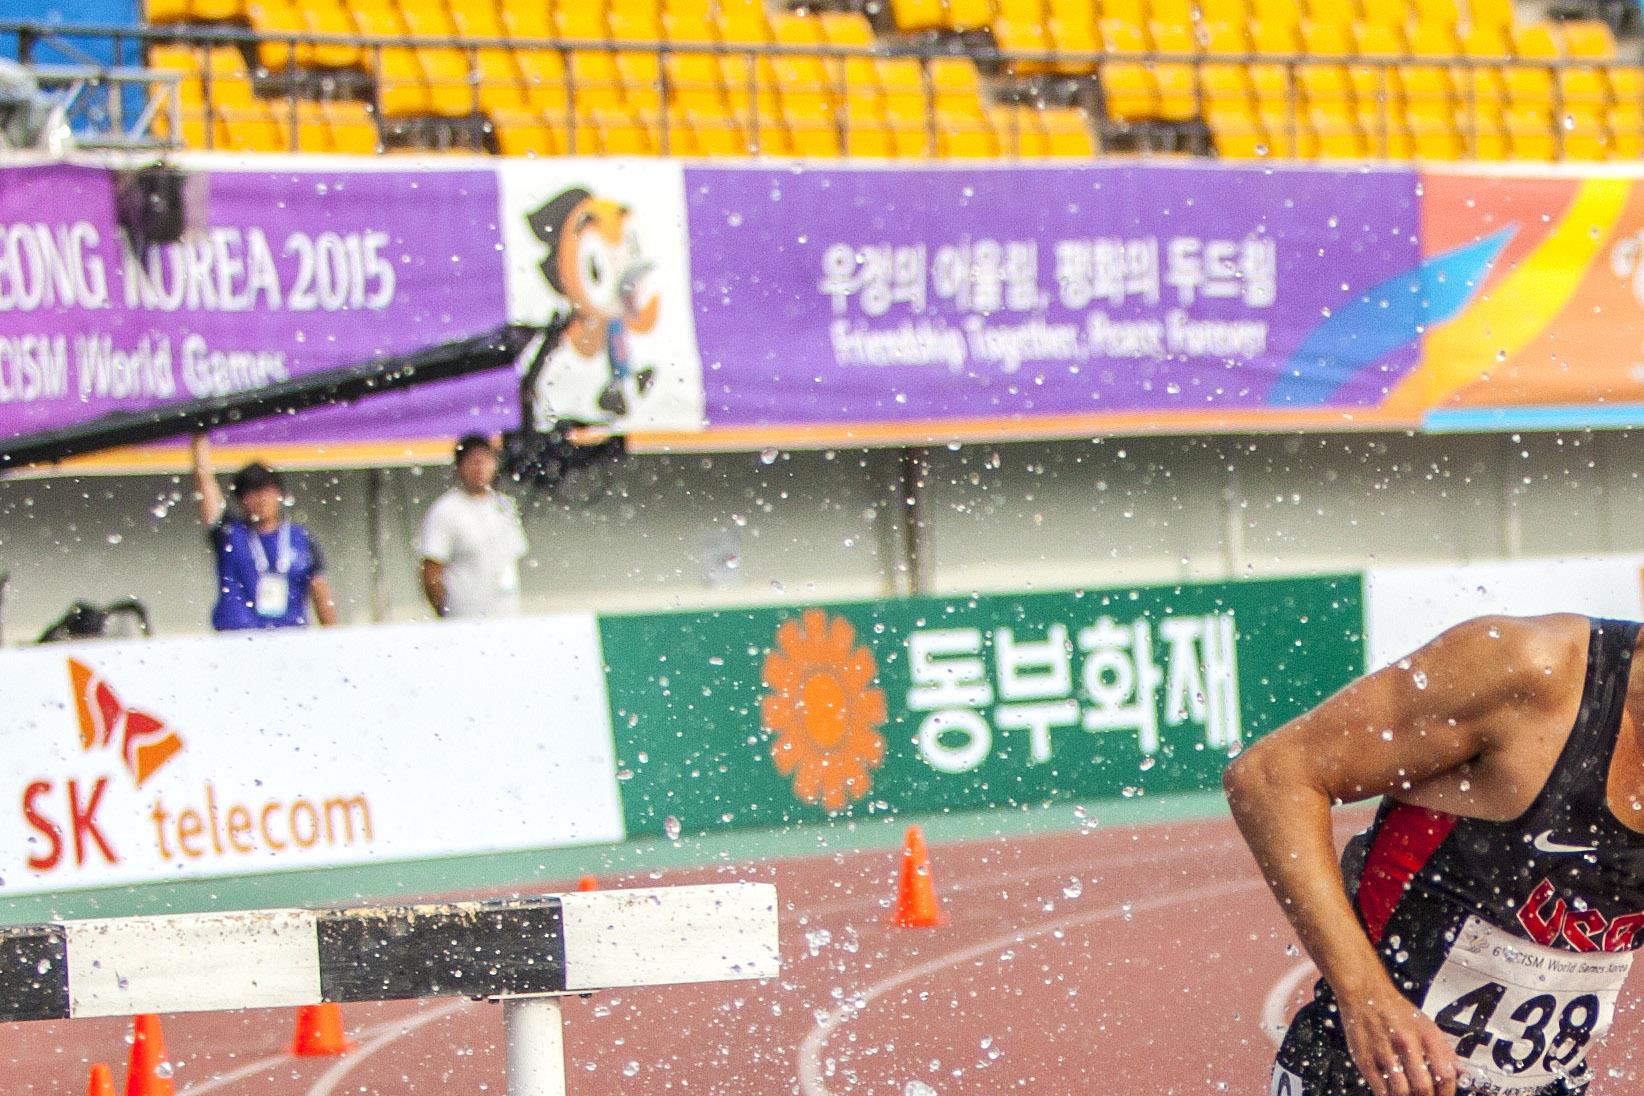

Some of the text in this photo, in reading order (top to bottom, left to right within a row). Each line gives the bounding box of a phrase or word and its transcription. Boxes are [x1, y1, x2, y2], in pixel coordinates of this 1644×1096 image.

[284, 231, 397, 311] 2015
[819, 241, 927, 316] 우정의
[1056, 236, 1160, 310] 평화의
[1165, 235, 1277, 308] 두드림
[76, 333, 175, 400] World
[181, 333, 289, 399] Games
[906, 613, 1241, 774] 동부화재
[22, 777, 374, 872] SK telecom
[1548, 958, 1576, 974] World
[1434, 981, 1601, 1074] 438
